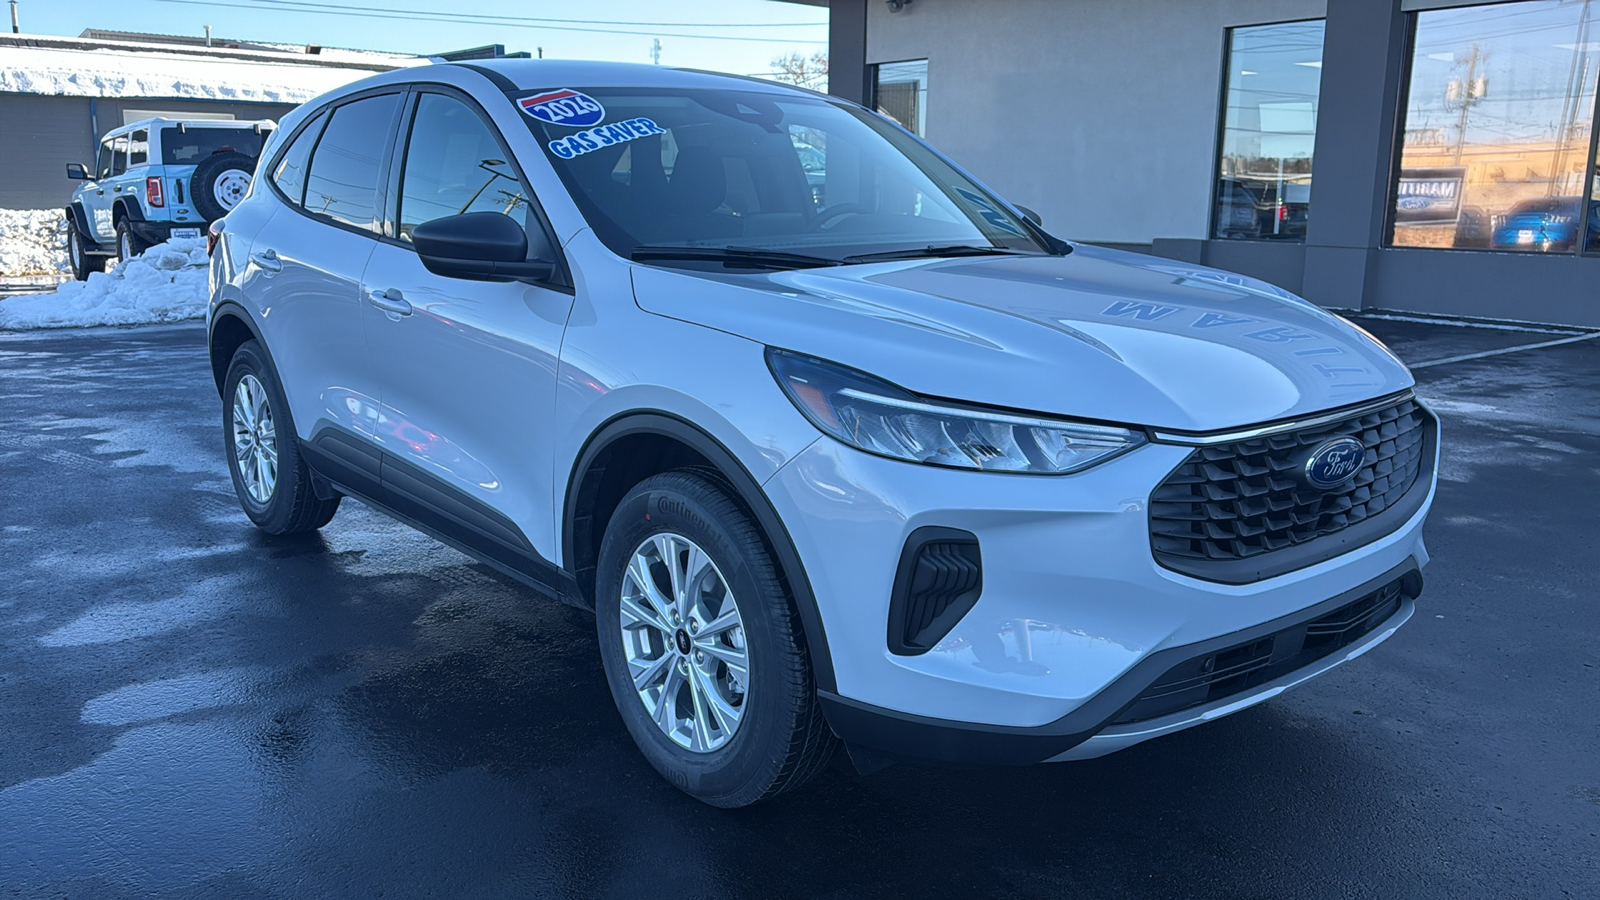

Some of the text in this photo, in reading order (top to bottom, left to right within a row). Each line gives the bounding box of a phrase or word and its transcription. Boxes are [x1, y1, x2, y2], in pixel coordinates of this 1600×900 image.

[535, 97, 599, 122] 2026
[550, 118, 664, 158] GAS SAVER
[1324, 449, 1356, 475] Ford
[659, 496, 721, 541] Continental
